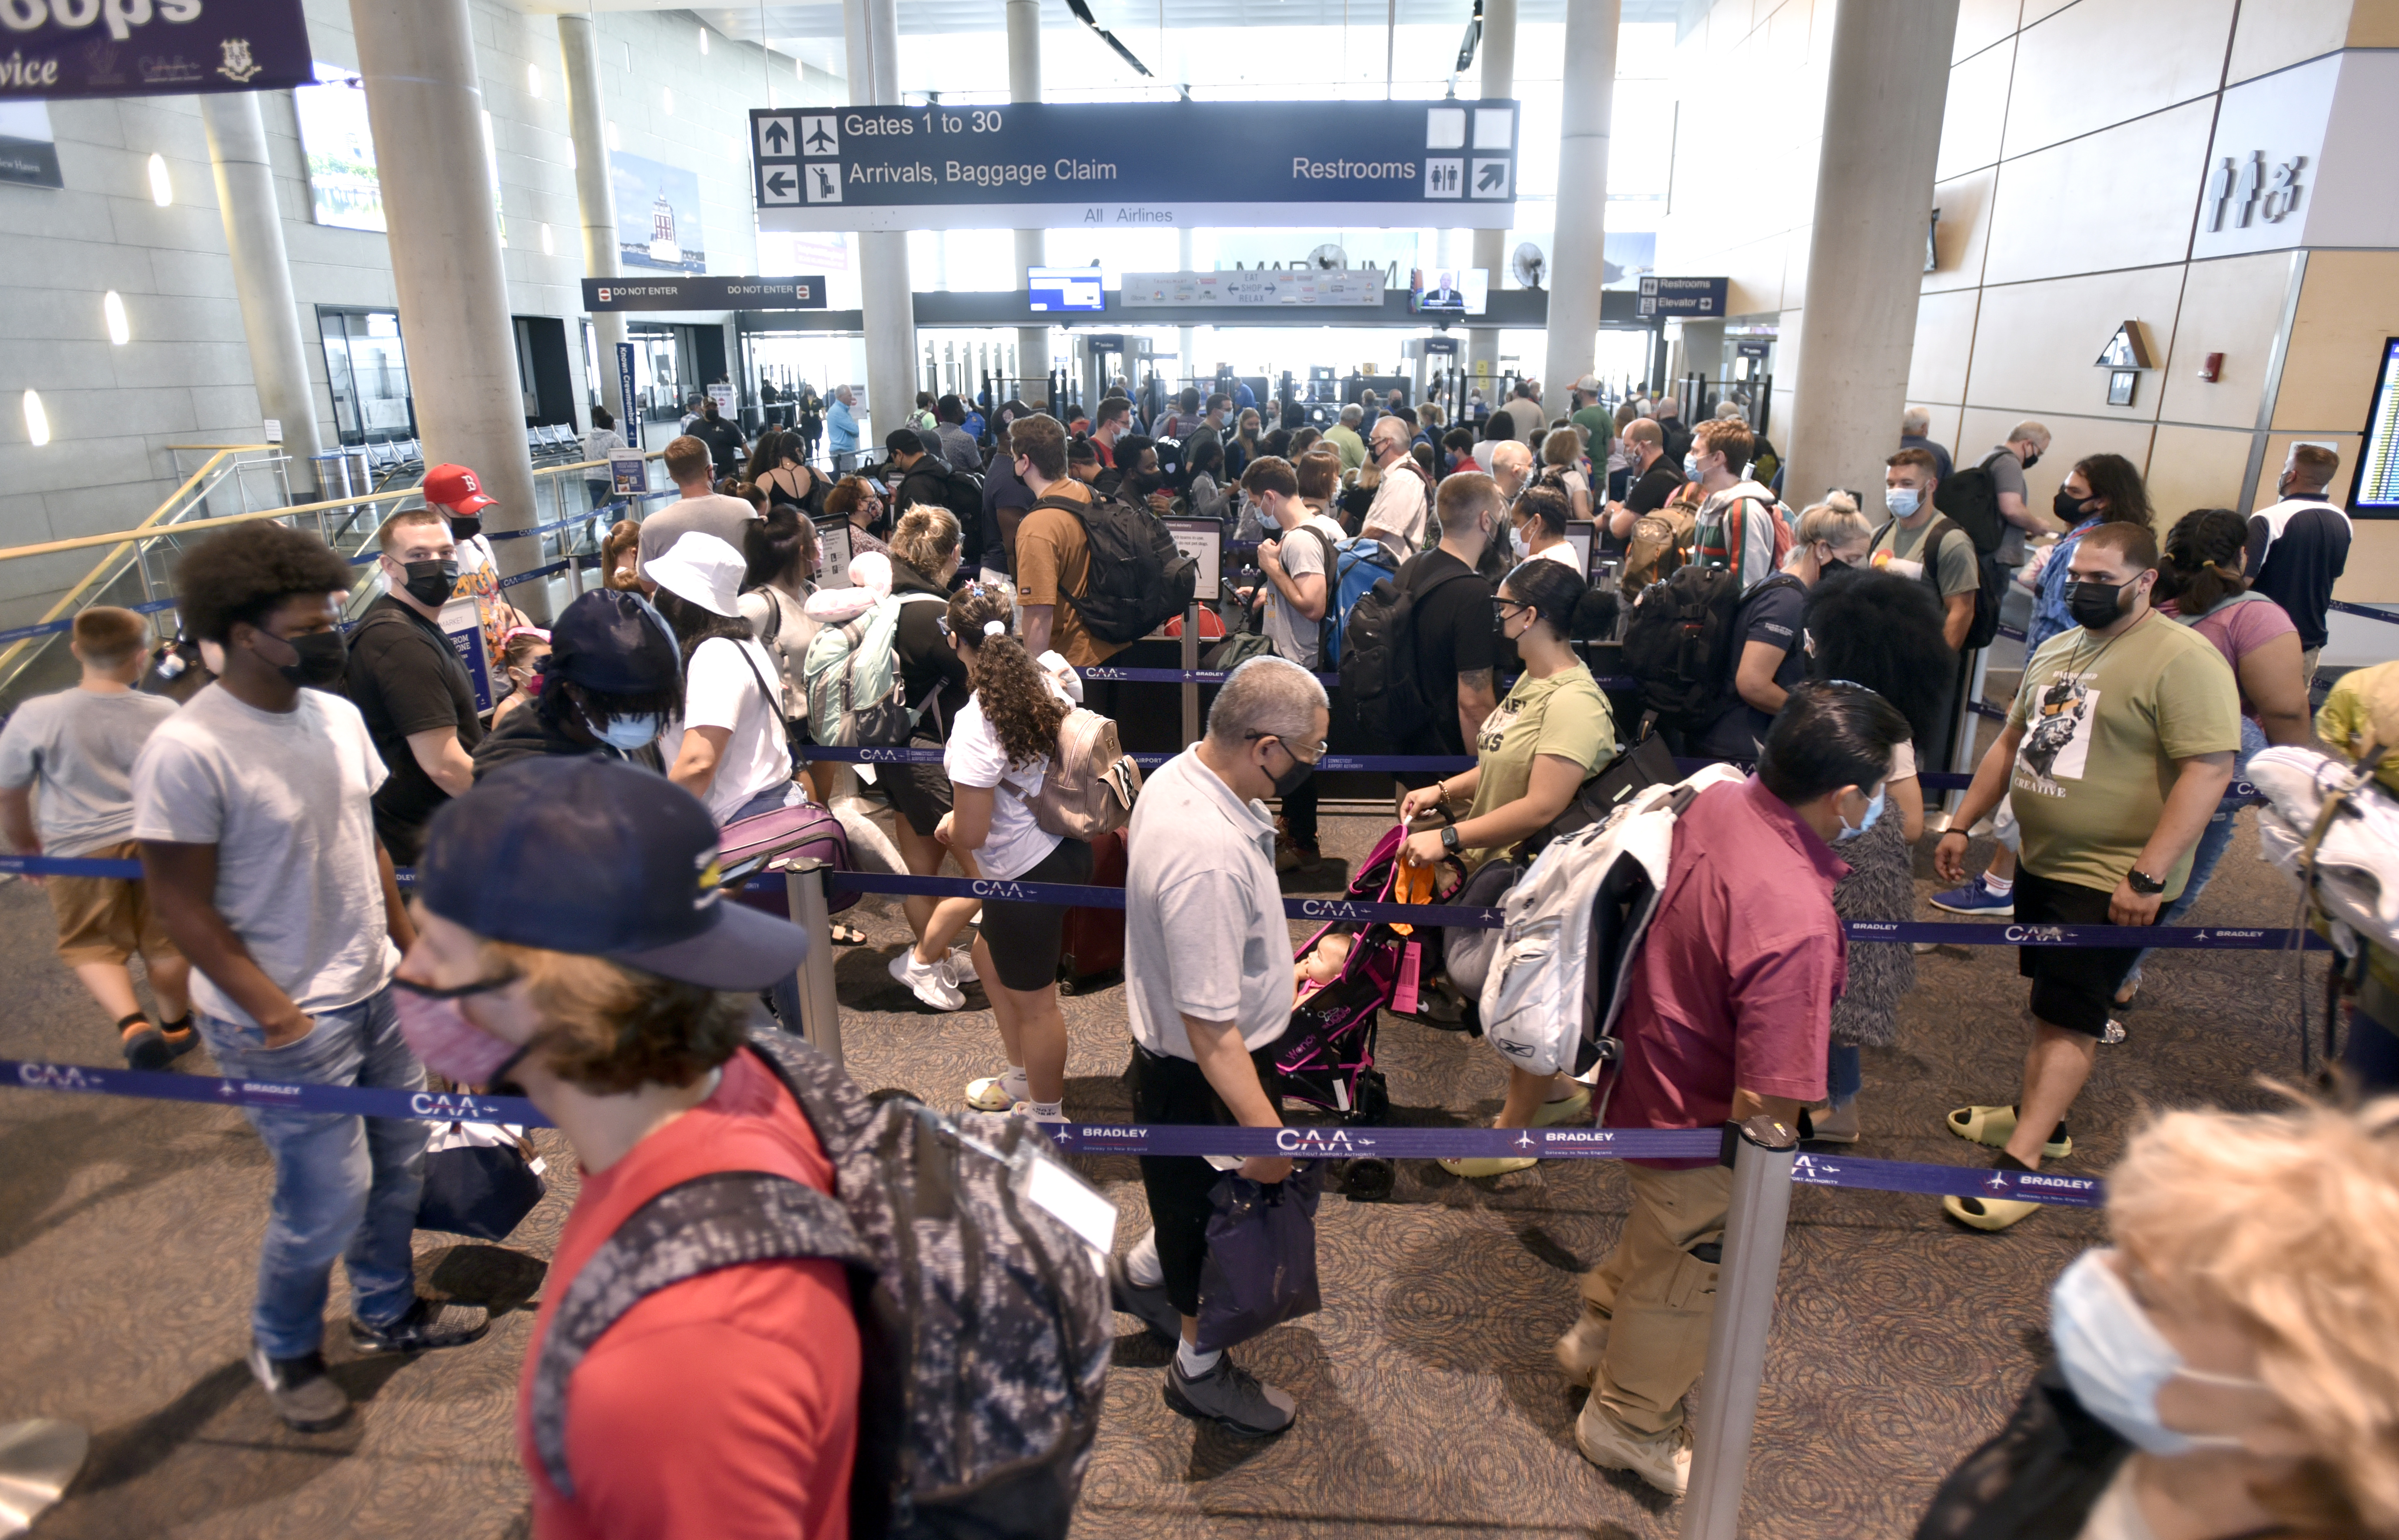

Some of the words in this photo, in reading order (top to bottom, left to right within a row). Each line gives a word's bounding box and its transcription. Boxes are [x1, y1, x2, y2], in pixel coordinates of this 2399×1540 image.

[845, 114, 913, 136] Gates
[922, 113, 932, 133] 1
[942, 113, 962, 133] to
[972, 110, 1002, 133] 30
[14, 160, 40, 172] Haven
[849, 162, 938, 185] Arrivals,
[946, 160, 1046, 186] Baggage
[1055, 159, 1116, 180] Claim
[1293, 157, 1416, 179] Restrooms
[1084, 208, 1103, 223] All
[1116, 208, 1173, 222] Airlines
[1245, 273, 1258, 282] EAT
[1661, 279, 1710, 289] Restrooms
[613, 287, 626, 295] DO
[628, 287, 646, 295] NOT
[648, 287, 678, 295] ENTER
[727, 286, 741, 294] DO
[743, 285, 761, 294] NOT
[764, 285, 793, 294] ENTER
[1241, 283, 1262, 292] SHOP
[1239, 294, 1264, 302] RELAX
[1659, 297, 1697, 307] Elevator
[620, 346, 628, 374] Known
[623, 375, 635, 426] Crewmember
[461, 475, 476, 491] B
[504, 577, 518, 586] CAA
[440, 617, 463, 627] MARKET
[1086, 667, 1118, 678] CAA
[860, 749, 897, 760] CAA
[2014, 777, 2066, 798] CREATIVE
[972, 880, 1023, 898] CAA
[1303, 900, 1357, 917] CAA
[2005, 926, 2061, 941] CAA
[20, 1064, 86, 1087] CAA
[243, 1083, 300, 1095] BRADLEY
[411, 1093, 478, 1117] CAA
[1083, 1128, 1147, 1138] BRADLEY
[1546, 1132, 1613, 1141] BRADLEY
[1277, 1129, 1353, 1151] CAA
[2020, 1175, 2094, 1190] BRADLEY
